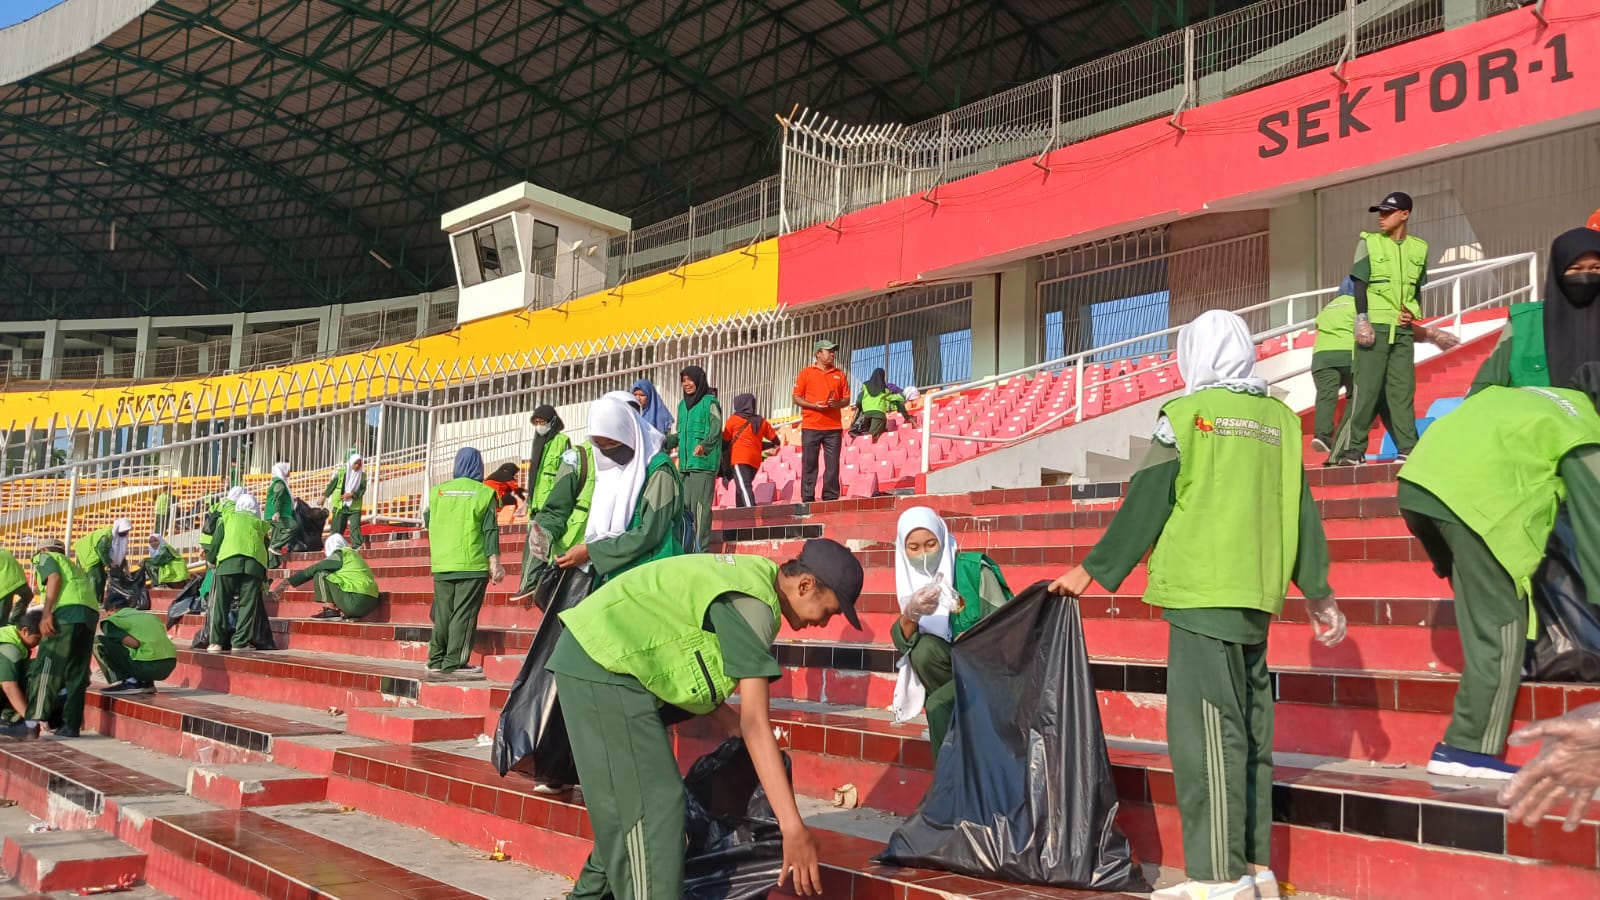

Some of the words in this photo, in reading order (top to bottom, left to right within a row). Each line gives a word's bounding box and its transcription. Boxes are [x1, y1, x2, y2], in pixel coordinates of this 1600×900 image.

[1258, 33, 1574, 158] SEKTOR-1
[1214, 417, 1260, 430] PASUKAN
[1214, 428, 1232, 436] SMK
